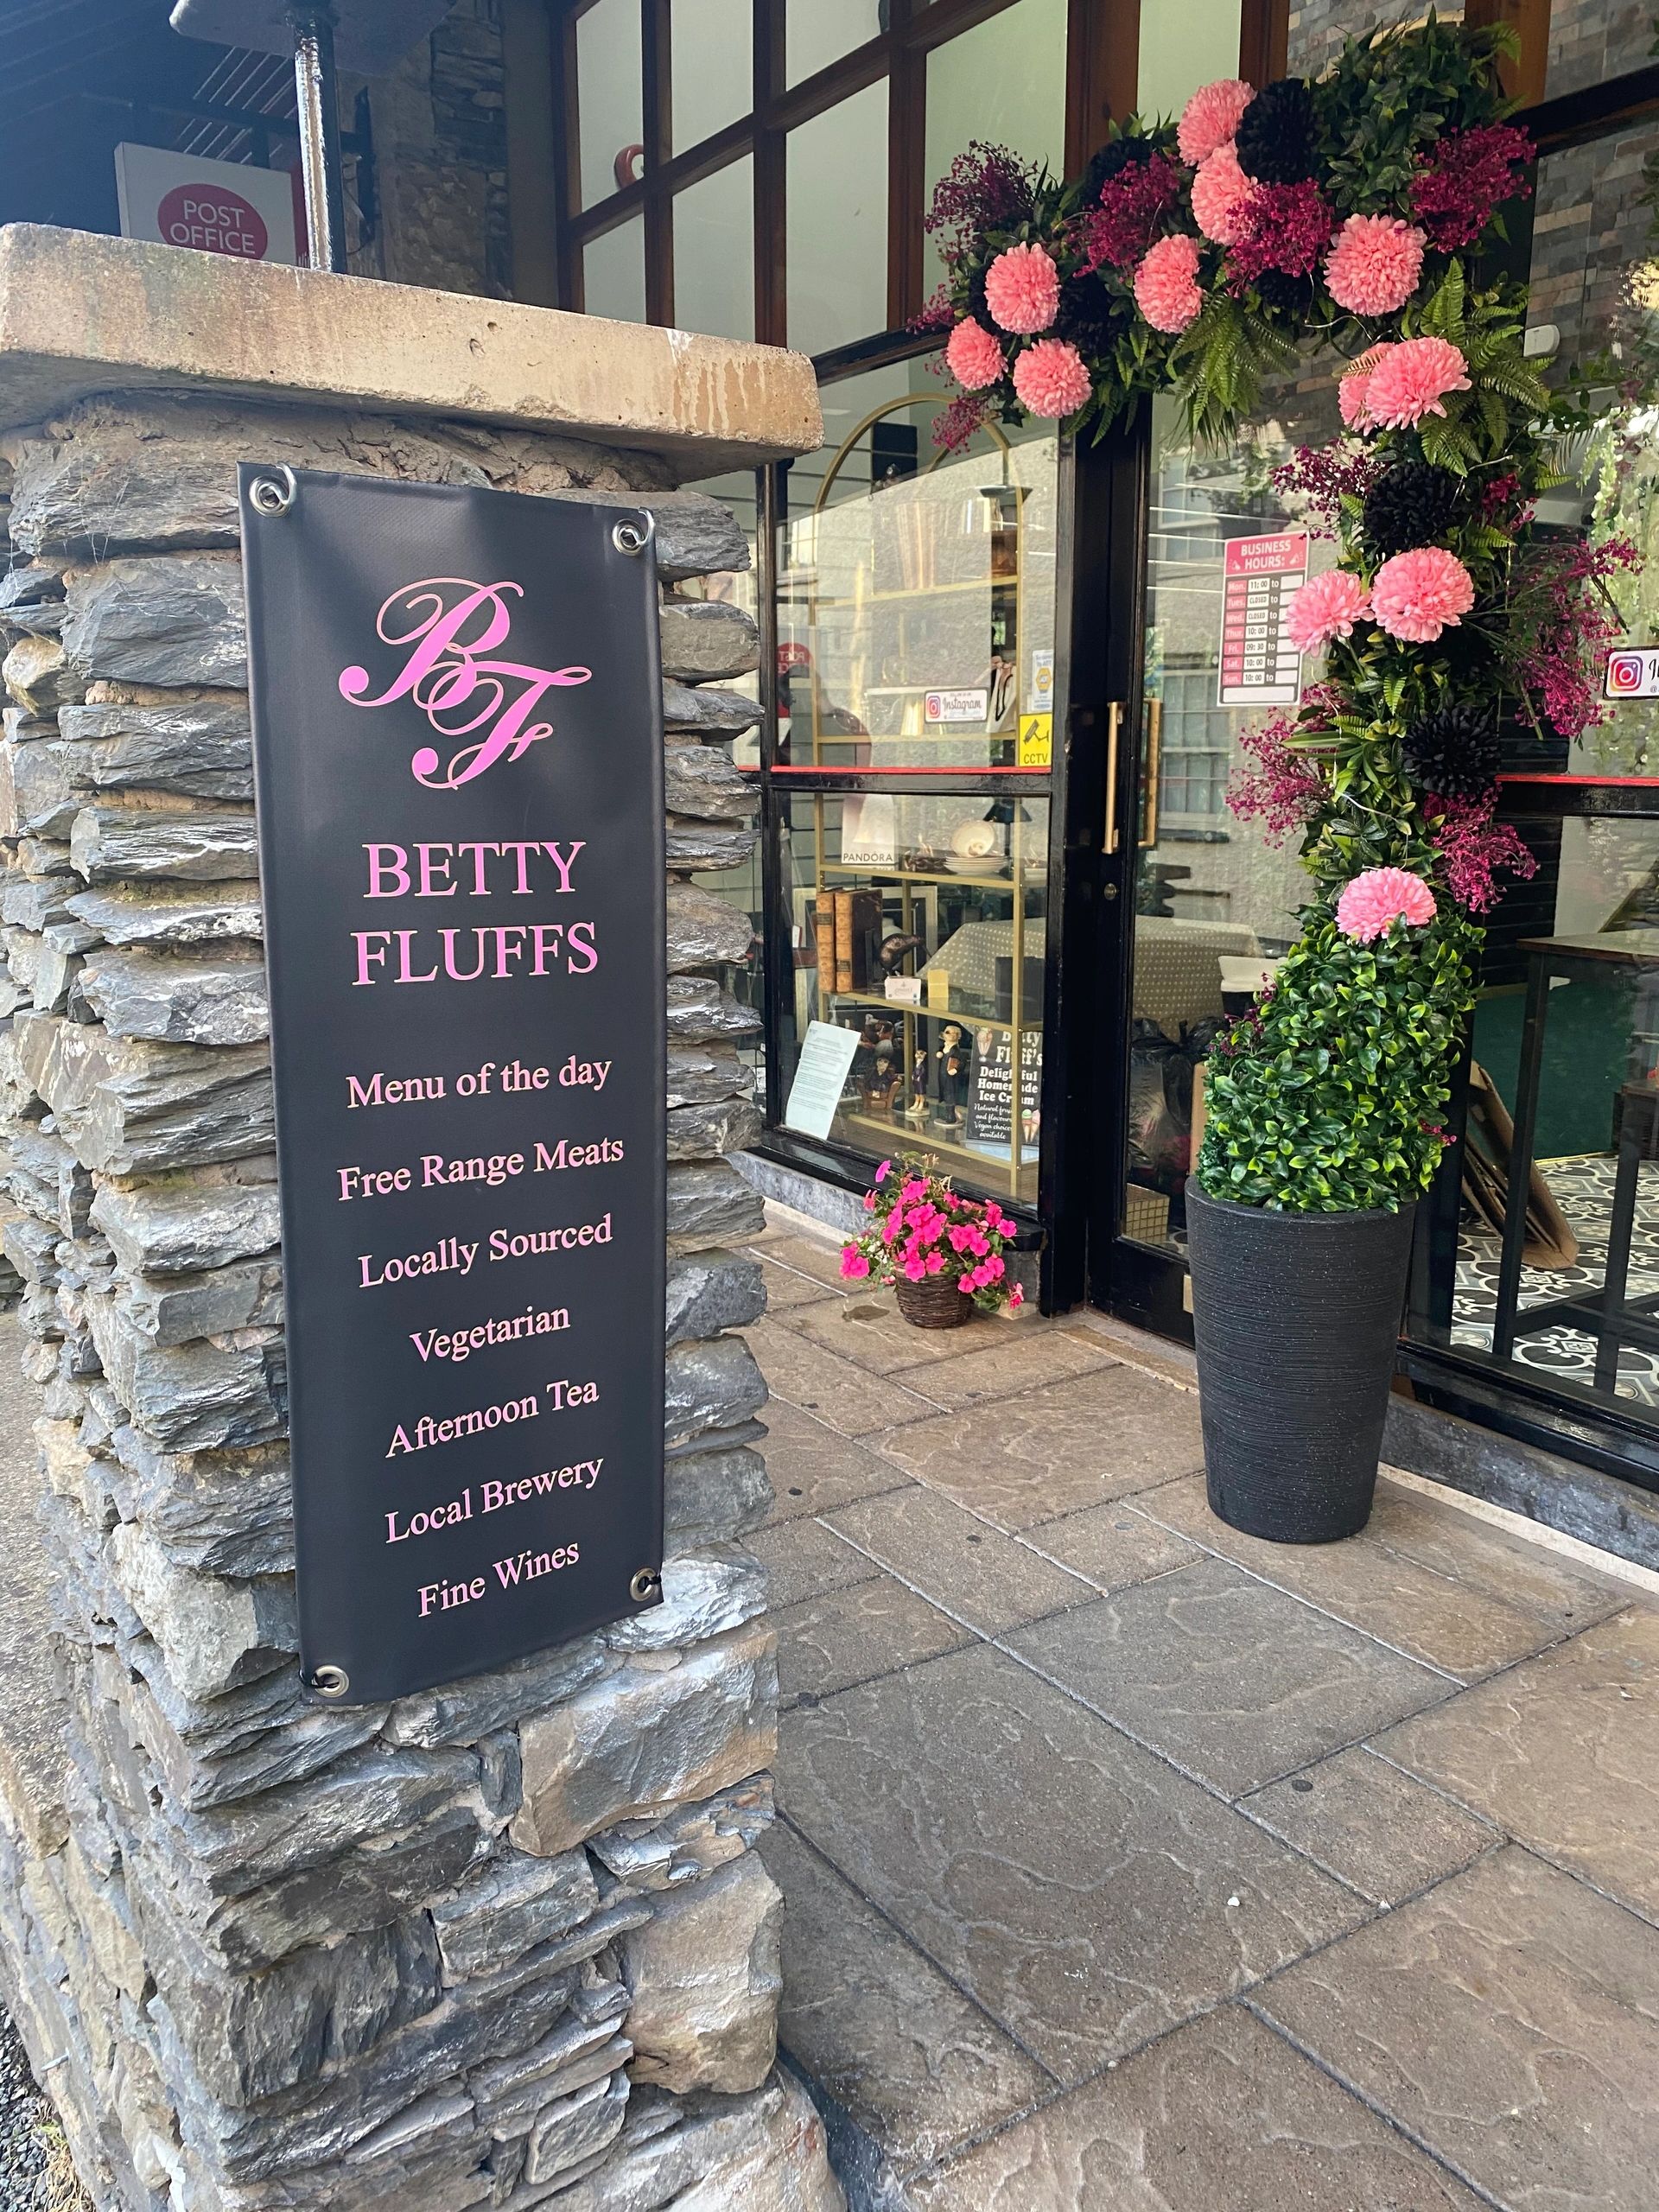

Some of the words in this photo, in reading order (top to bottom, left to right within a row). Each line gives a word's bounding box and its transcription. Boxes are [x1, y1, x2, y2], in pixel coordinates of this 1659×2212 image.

[184, 200, 245, 228] POST
[169, 222, 256, 254] OFFICE
[1241, 540, 1292, 556] BUSINESS
[1244, 555, 1286, 570] HOURS:
[1249, 595, 1267, 604] CLOSED
[1268, 626, 1276, 635] to
[943, 697, 982, 715] Instagram
[1023, 753, 1048, 764] CCTV
[362, 841, 586, 898] BETTY
[842, 852, 894, 862] PANDORA
[351, 922, 599, 985] FLUFFS
[346, 1073, 446, 1108] Menu
[456, 1063, 495, 1096] of
[500, 1060, 549, 1091] the
[558, 1056, 612, 1090] day
[979, 1090, 995, 1102] Ice
[974, 1103, 998, 1112] Natural
[974, 1121, 992, 1132] Vegan
[993, 1122, 1012, 1131] choice
[337, 1167, 410, 1200] Free
[420, 1154, 524, 1186] Range
[534, 1138, 623, 1172] Meats
[358, 1237, 479, 1287] Locally
[489, 1213, 613, 1261] Sourced
[410, 1306, 570, 1361] Vegetarian
[385, 1396, 539, 1458] Afternoon
[547, 1380, 599, 1410] Tea
[385, 1489, 473, 1543] Local
[480, 1459, 603, 1513] Brewery
[417, 1578, 485, 1617] Fine
[493, 1543, 579, 1588] Wines
